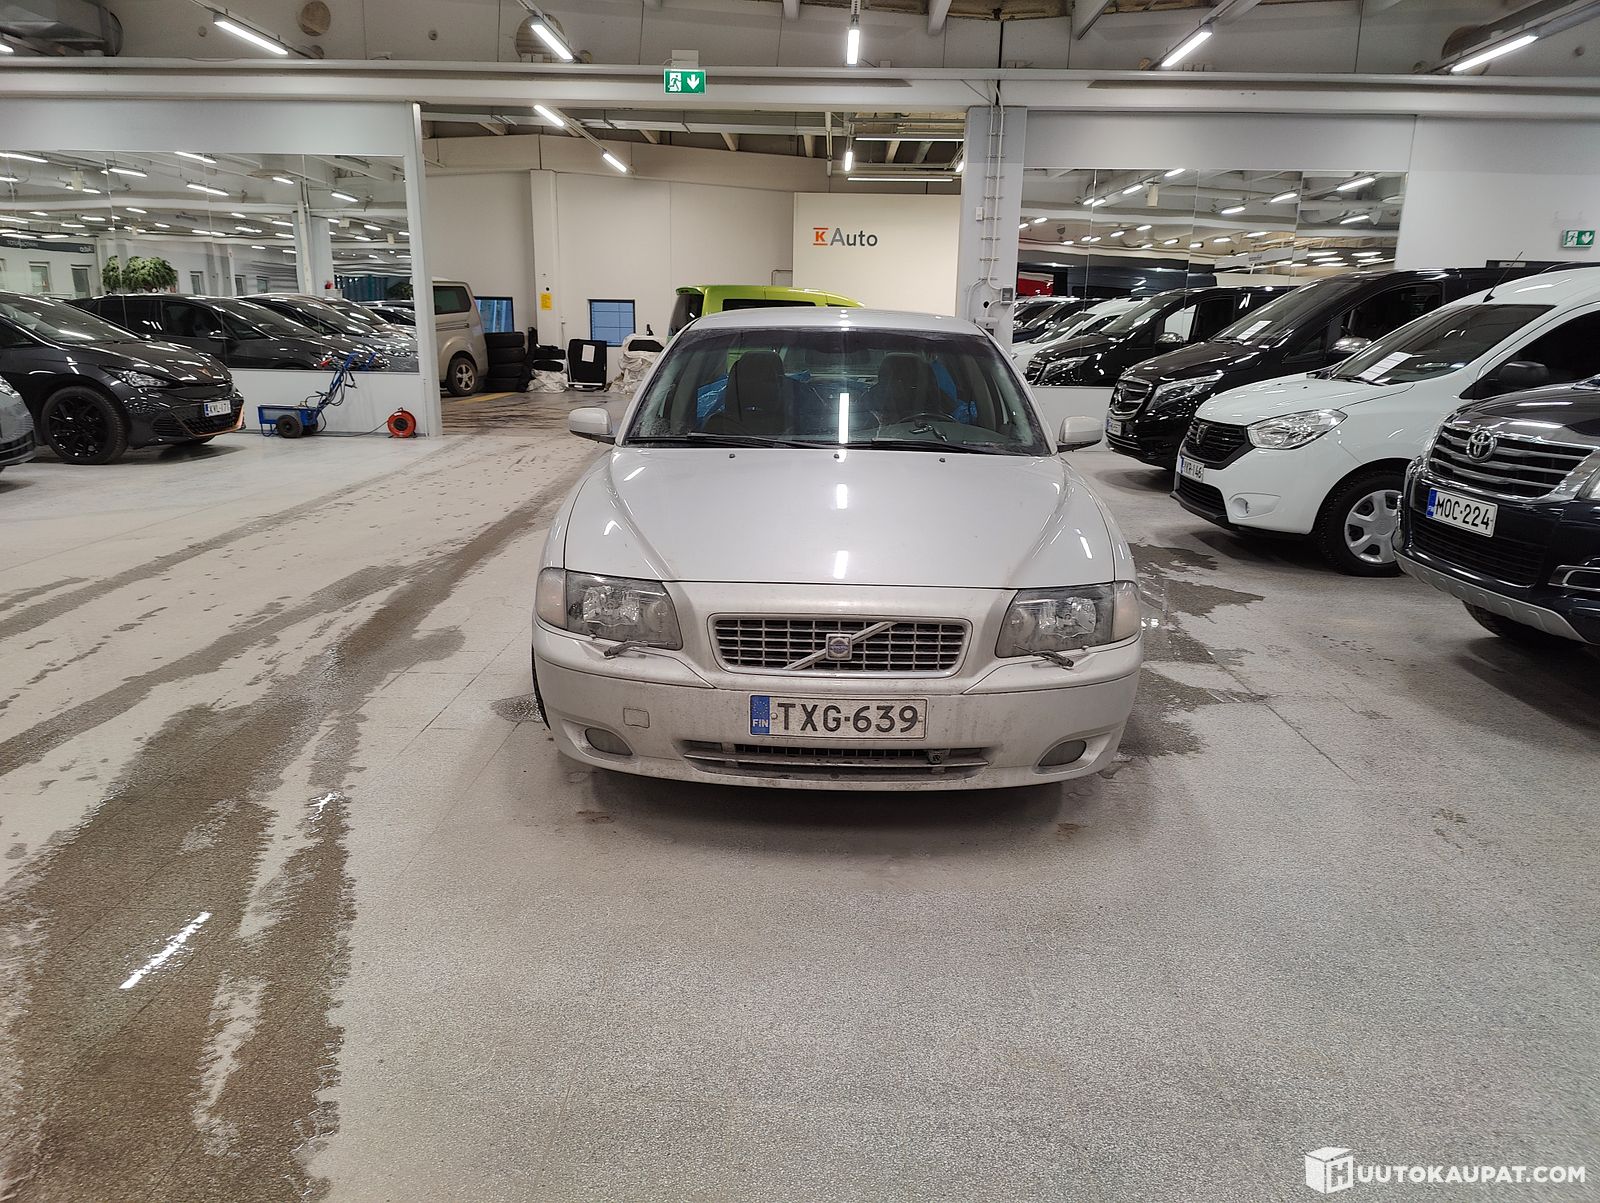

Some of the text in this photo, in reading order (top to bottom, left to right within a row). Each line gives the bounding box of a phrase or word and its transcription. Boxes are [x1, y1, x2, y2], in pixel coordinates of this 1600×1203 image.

[830, 228, 878, 246] Auto
[1435, 496, 1490, 531] MOC-224
[752, 703, 919, 733] FIN TXG-639
